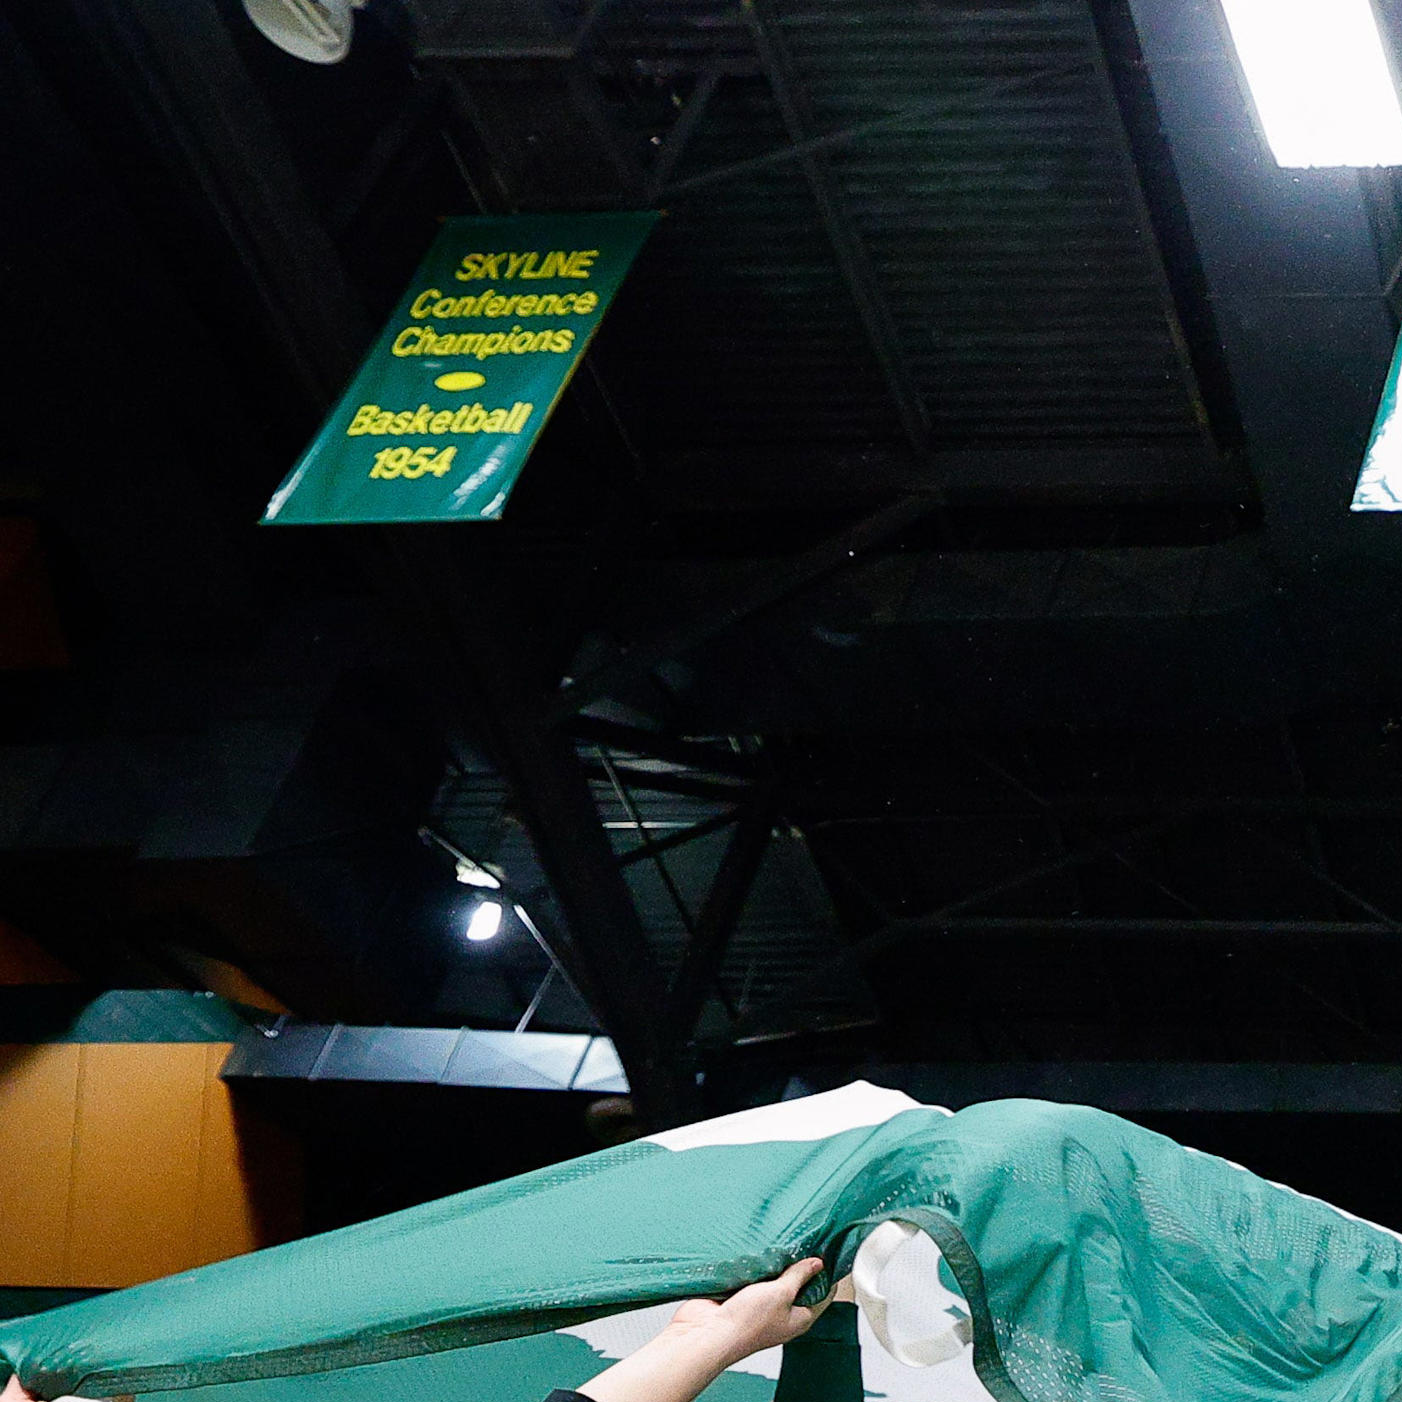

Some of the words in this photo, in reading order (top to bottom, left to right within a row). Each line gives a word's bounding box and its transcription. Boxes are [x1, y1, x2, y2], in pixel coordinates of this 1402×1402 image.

[455, 250, 599, 282] SKYLINE
[410, 288, 599, 319] Conference
[392, 325, 576, 360] Champions
[347, 402, 534, 437] Basketball
[368, 446, 458, 480] 1954
